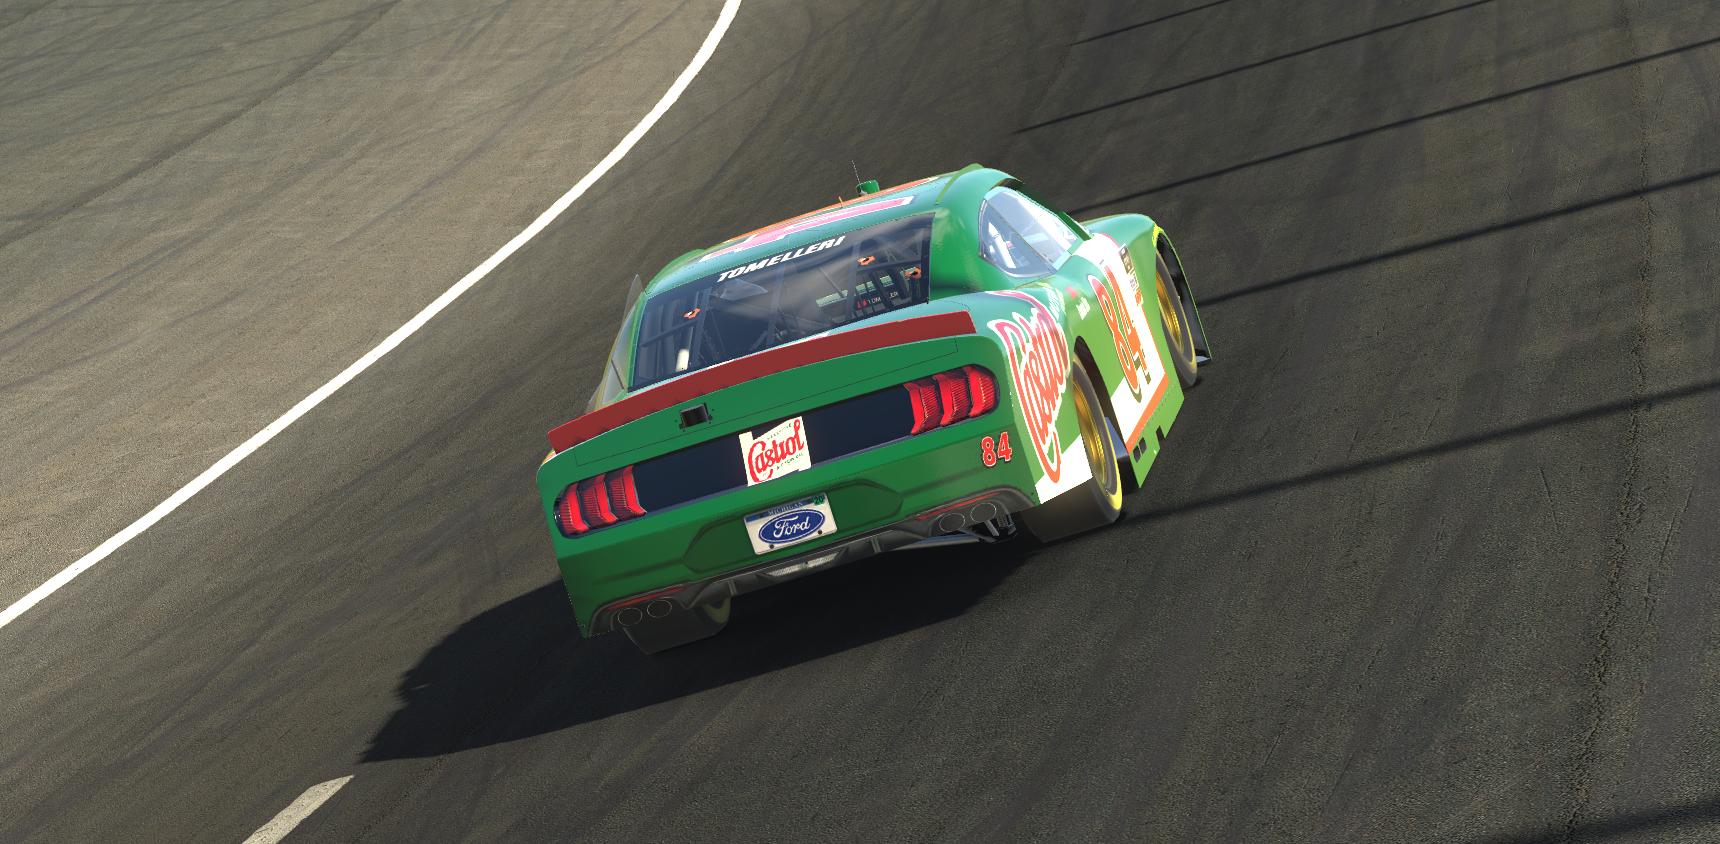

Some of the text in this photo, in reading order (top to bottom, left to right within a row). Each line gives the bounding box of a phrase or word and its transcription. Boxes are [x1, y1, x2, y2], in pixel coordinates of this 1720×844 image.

[716, 235, 846, 283] TOMELLERI
[985, 291, 1071, 484] Castrol
[747, 418, 805, 483] Castrol
[981, 431, 1013, 467] 84
[773, 515, 811, 539] Ford
